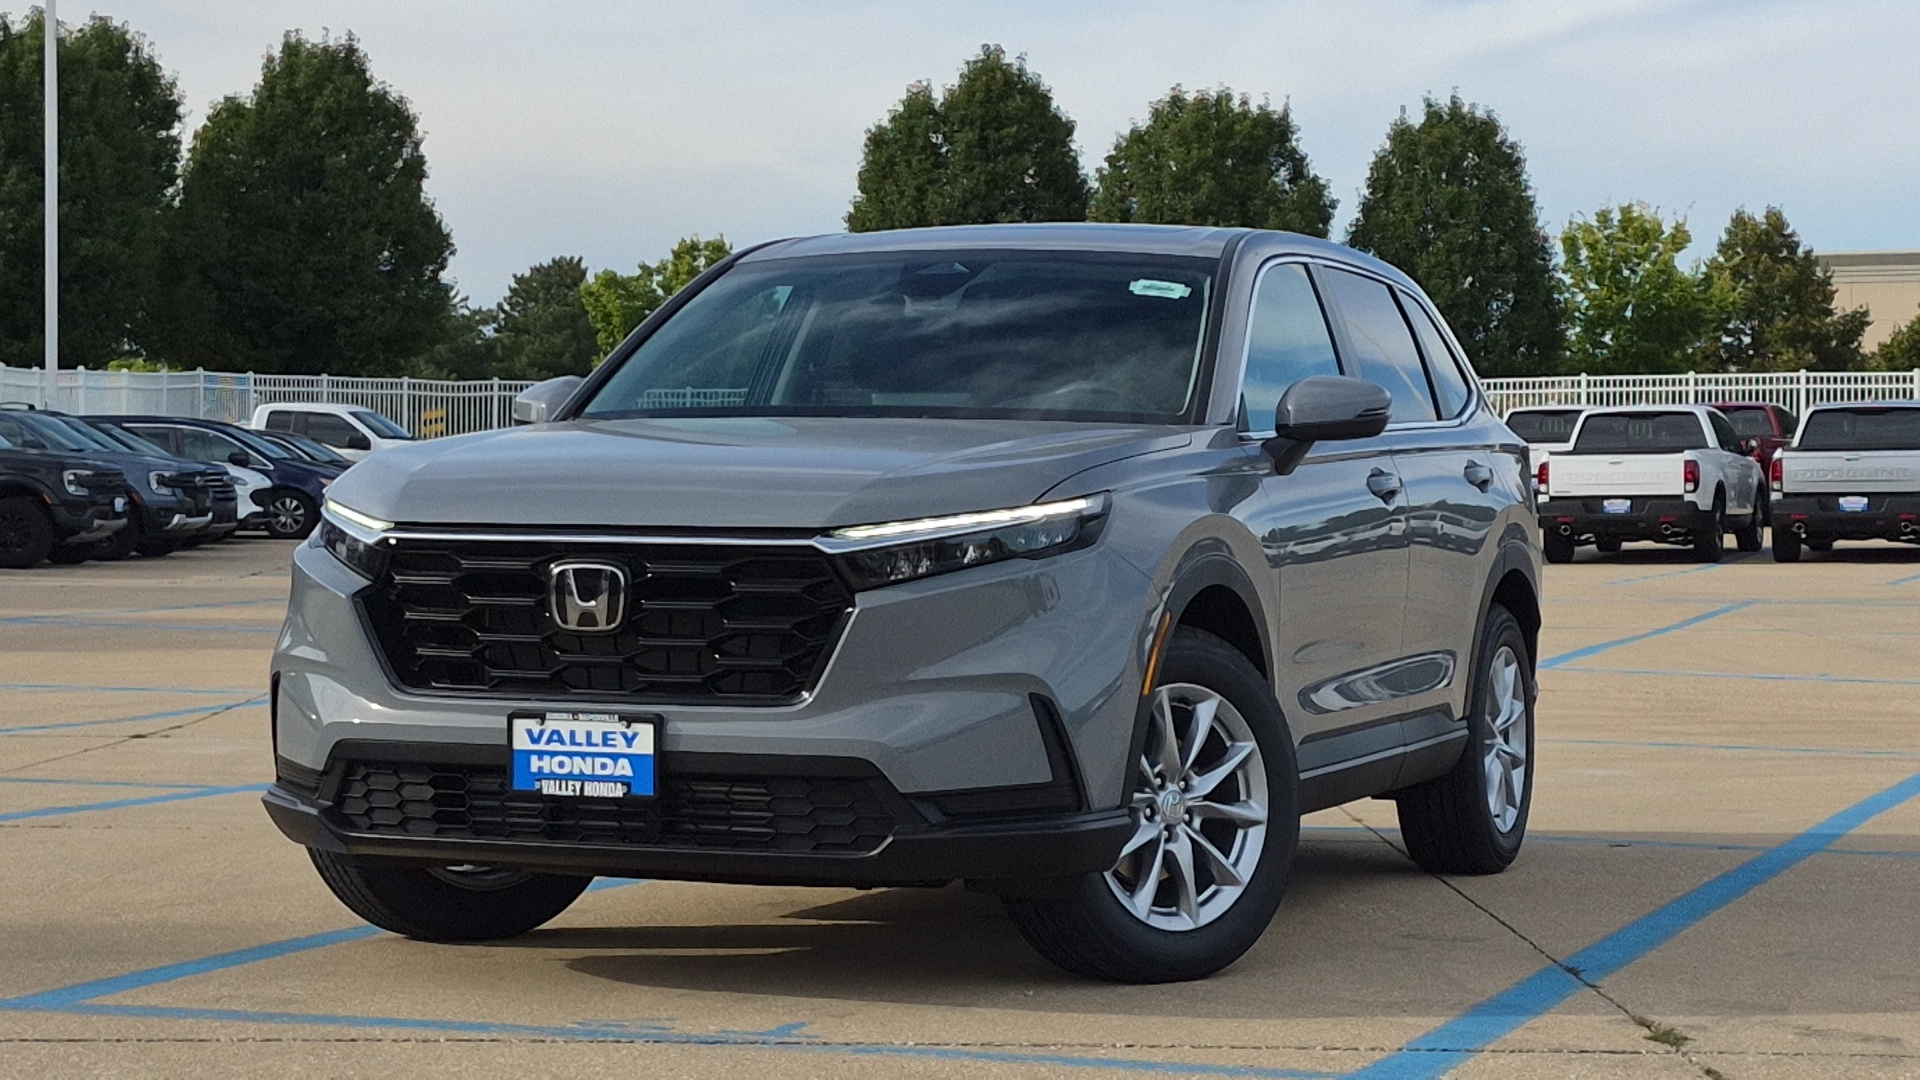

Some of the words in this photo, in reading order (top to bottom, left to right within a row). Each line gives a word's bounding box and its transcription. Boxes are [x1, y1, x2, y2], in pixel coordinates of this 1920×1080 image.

[525, 728, 639, 748] VALLEY
[530, 754, 634, 777] HONDA
[541, 779, 582, 797] VALLEY
[583, 780, 624, 798] HONDA
